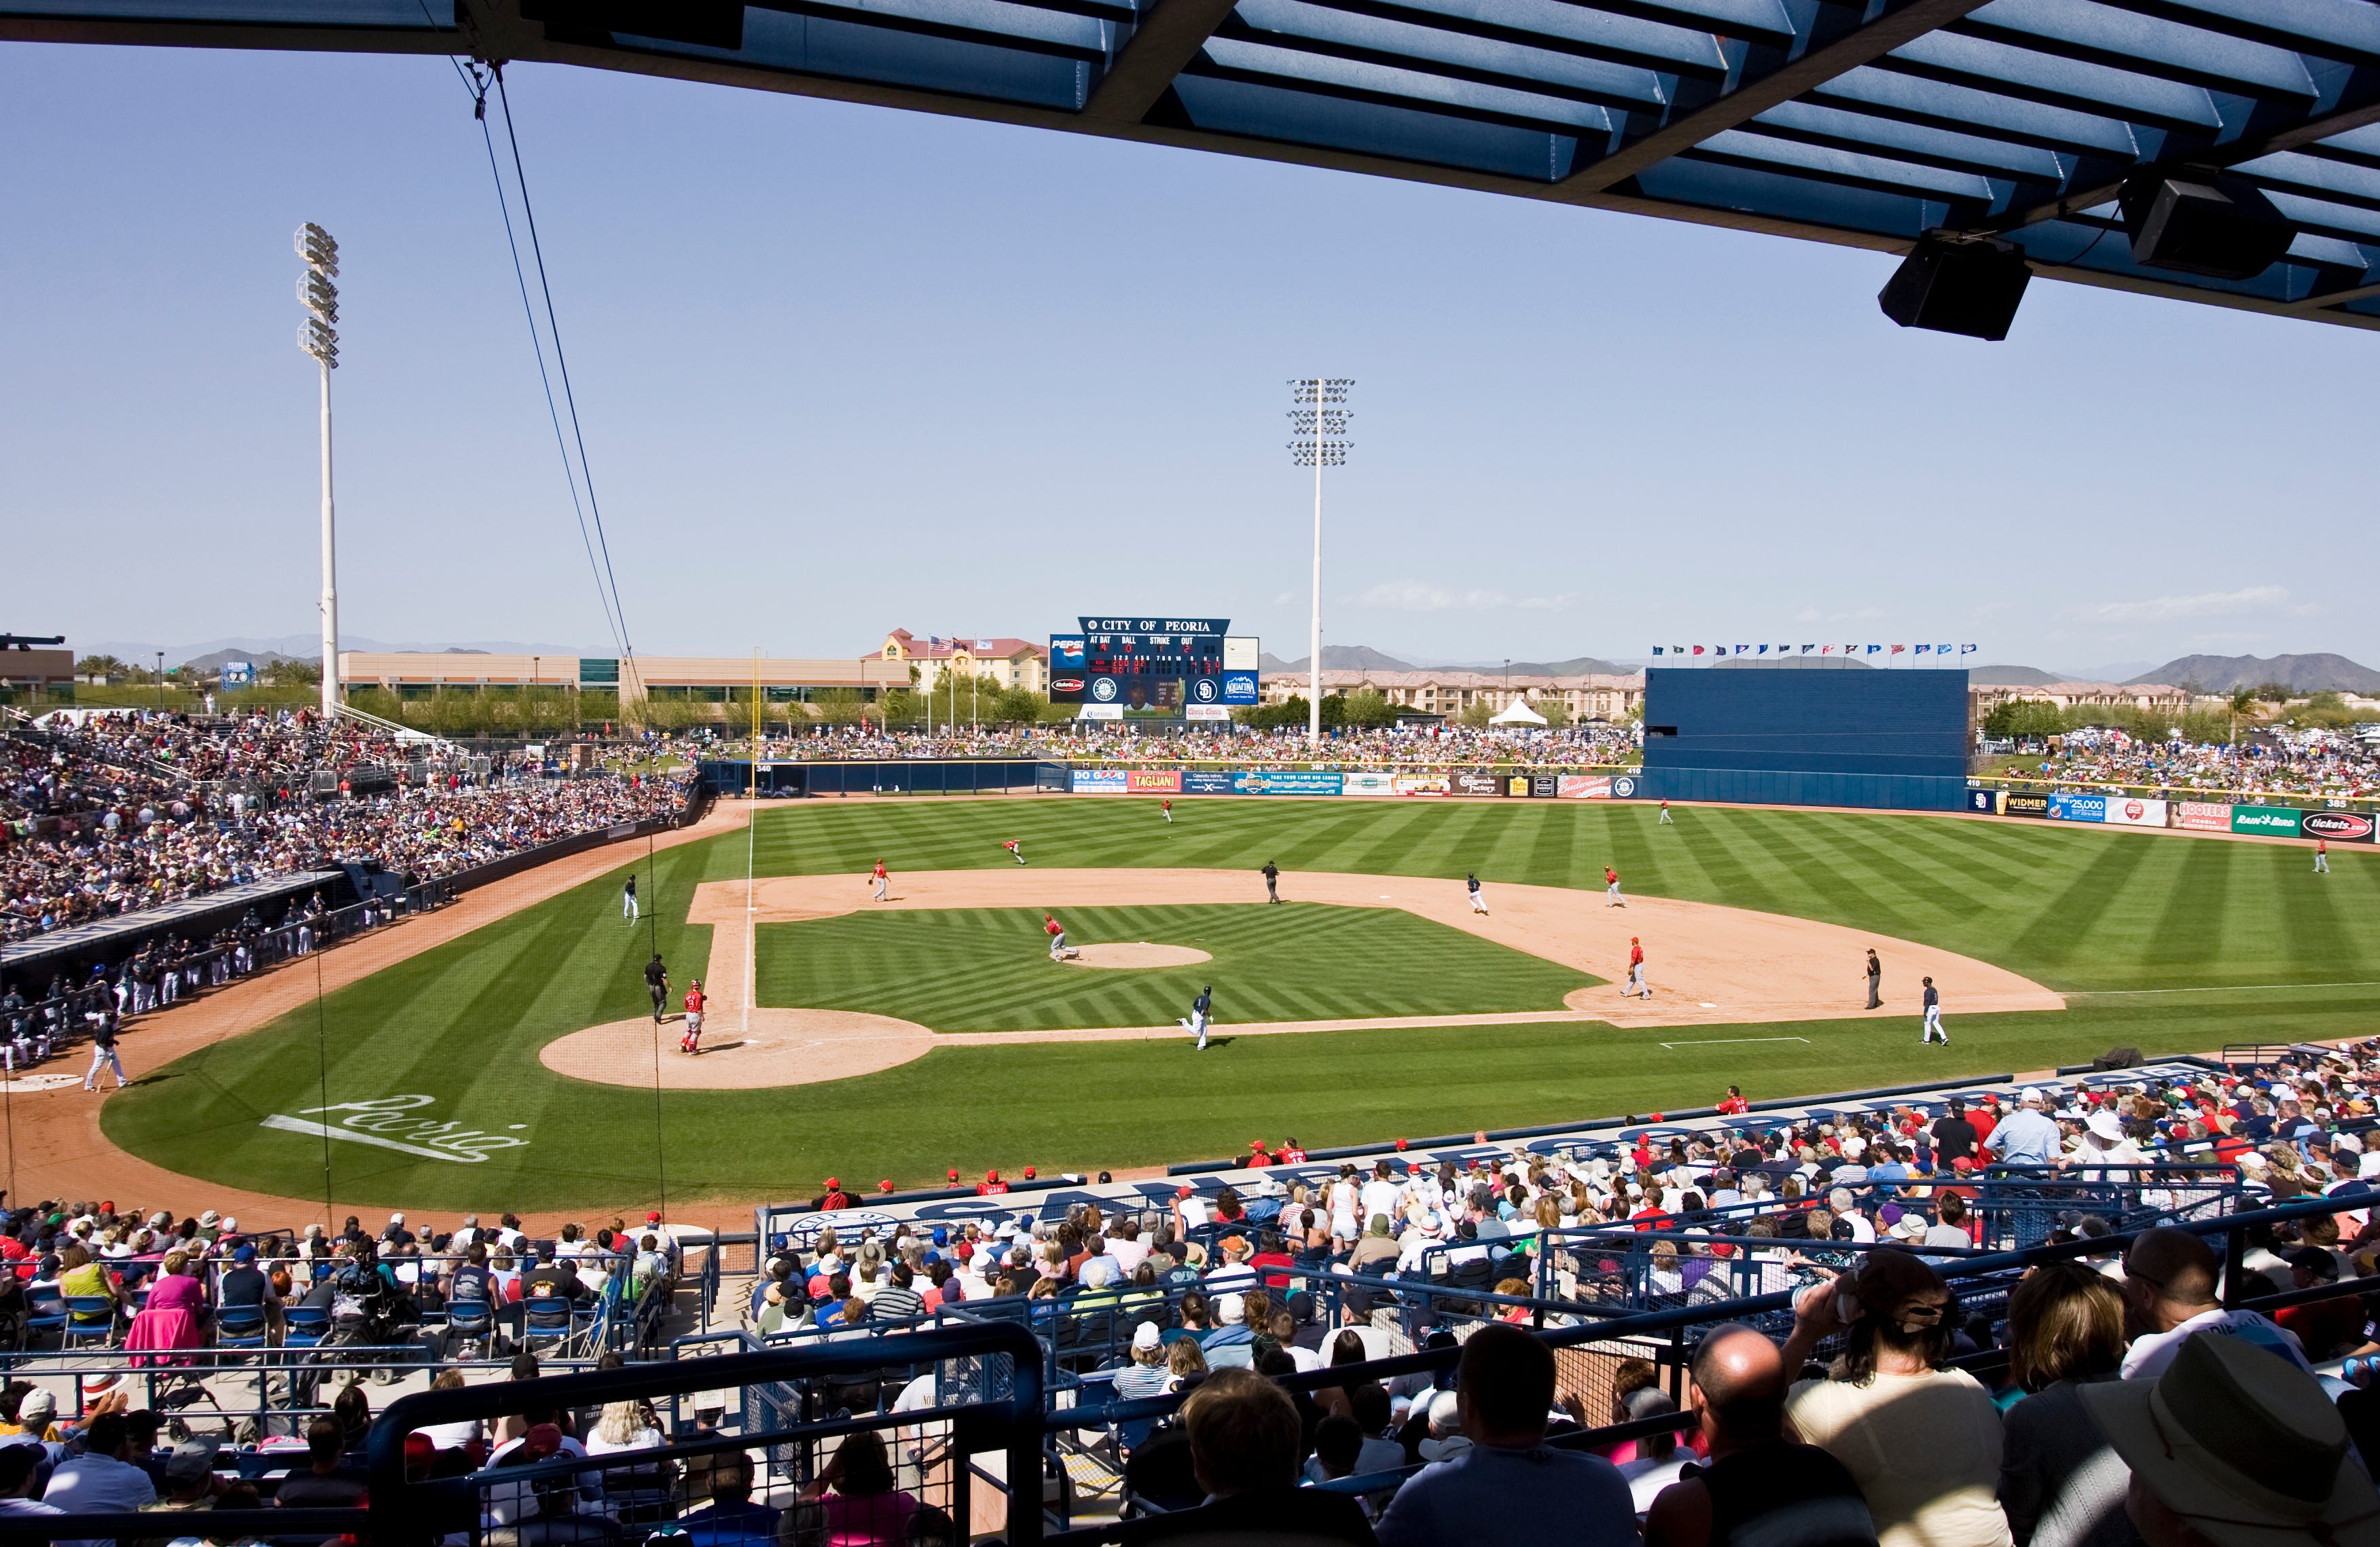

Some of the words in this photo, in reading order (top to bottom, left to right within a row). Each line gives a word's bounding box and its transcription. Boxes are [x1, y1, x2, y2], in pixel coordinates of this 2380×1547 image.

[1102, 621, 1131, 631] CITY
[1140, 621, 1156, 631] OF
[1165, 621, 1210, 631] PEORIA
[1052, 640, 1085, 649] PEPSI
[1090, 636, 1098, 644] AT
[1100, 636, 1111, 644] BAT
[1121, 636, 1136, 644] BALL
[1149, 636, 1170, 644] STRIKE
[1180, 636, 1193, 644] OUT
[1225, 681, 1256, 694] AQUAFINA
[1074, 771, 1090, 780] DO
[1093, 771, 1125, 780] GOOD
[1134, 776, 1174, 787] TAGLIANI
[1557, 776, 1610, 795] Budweiser
[2008, 798, 2047, 808] WIDMER
[2070, 799, 2104, 811] $25,000
[2327, 799, 2347, 808] 385
[2127, 806, 2142, 814] G2
[2179, 802, 2231, 818] HOOTERS
[2236, 814, 2261, 825] RAIN
[2270, 816, 2296, 827] BIRD
[2311, 818, 2366, 831] tickets.com
[798, 1213, 839, 1228] CITY
